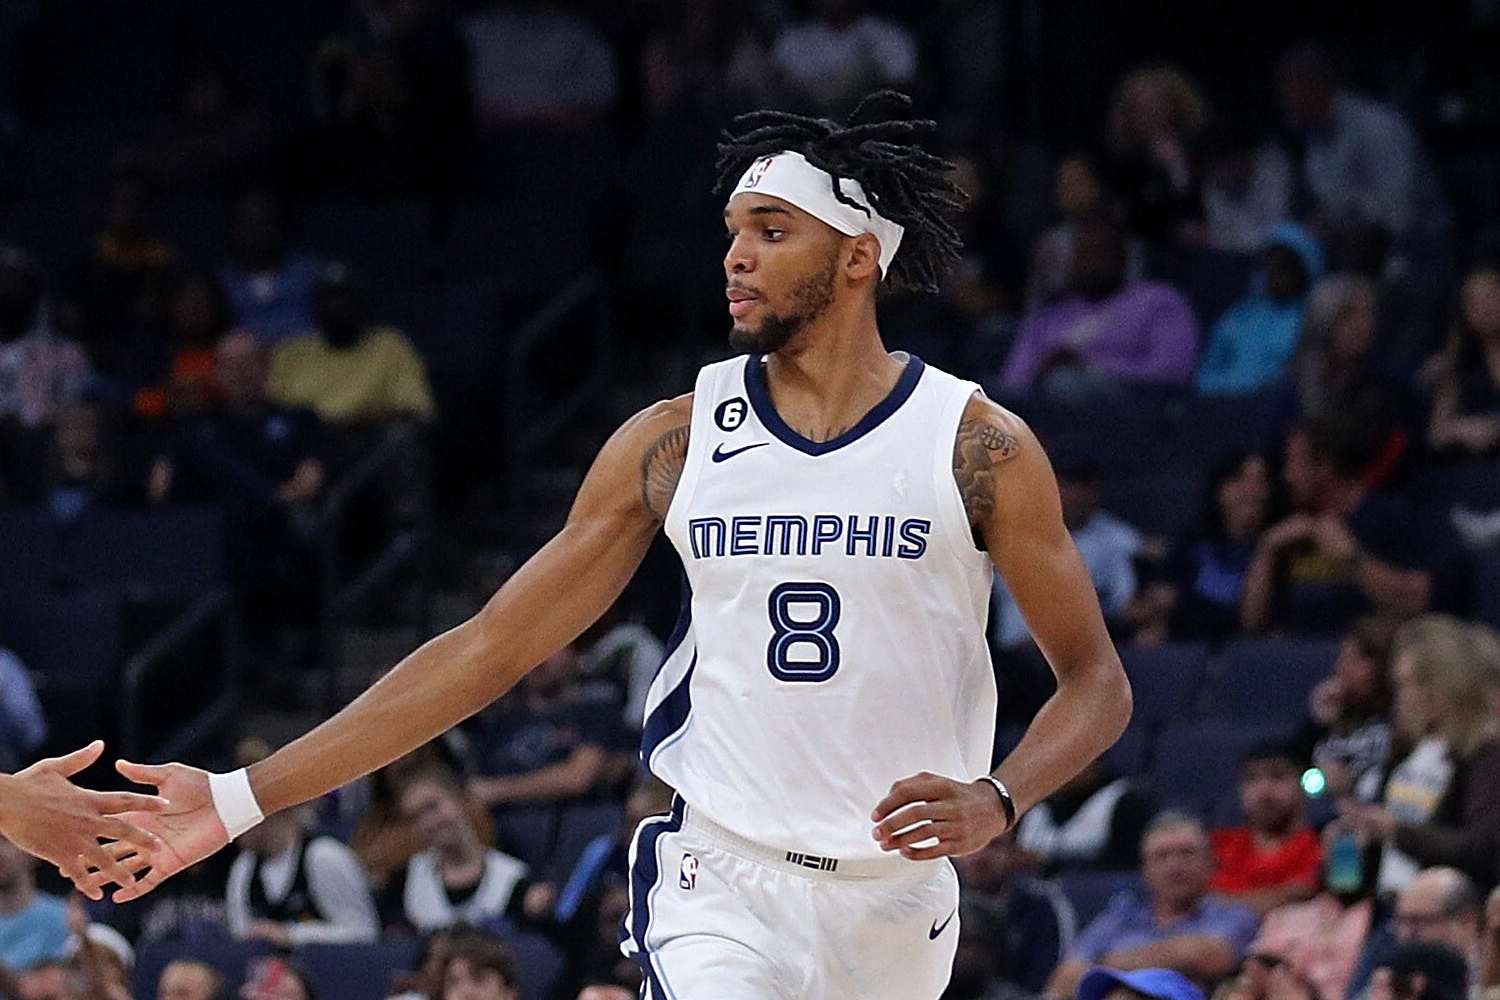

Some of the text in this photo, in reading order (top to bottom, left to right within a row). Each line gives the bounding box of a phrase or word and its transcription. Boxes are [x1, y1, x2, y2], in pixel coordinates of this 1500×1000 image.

[722, 399, 743, 428] 6
[689, 515, 931, 559] MEMPHIS
[767, 582, 840, 682] 8
